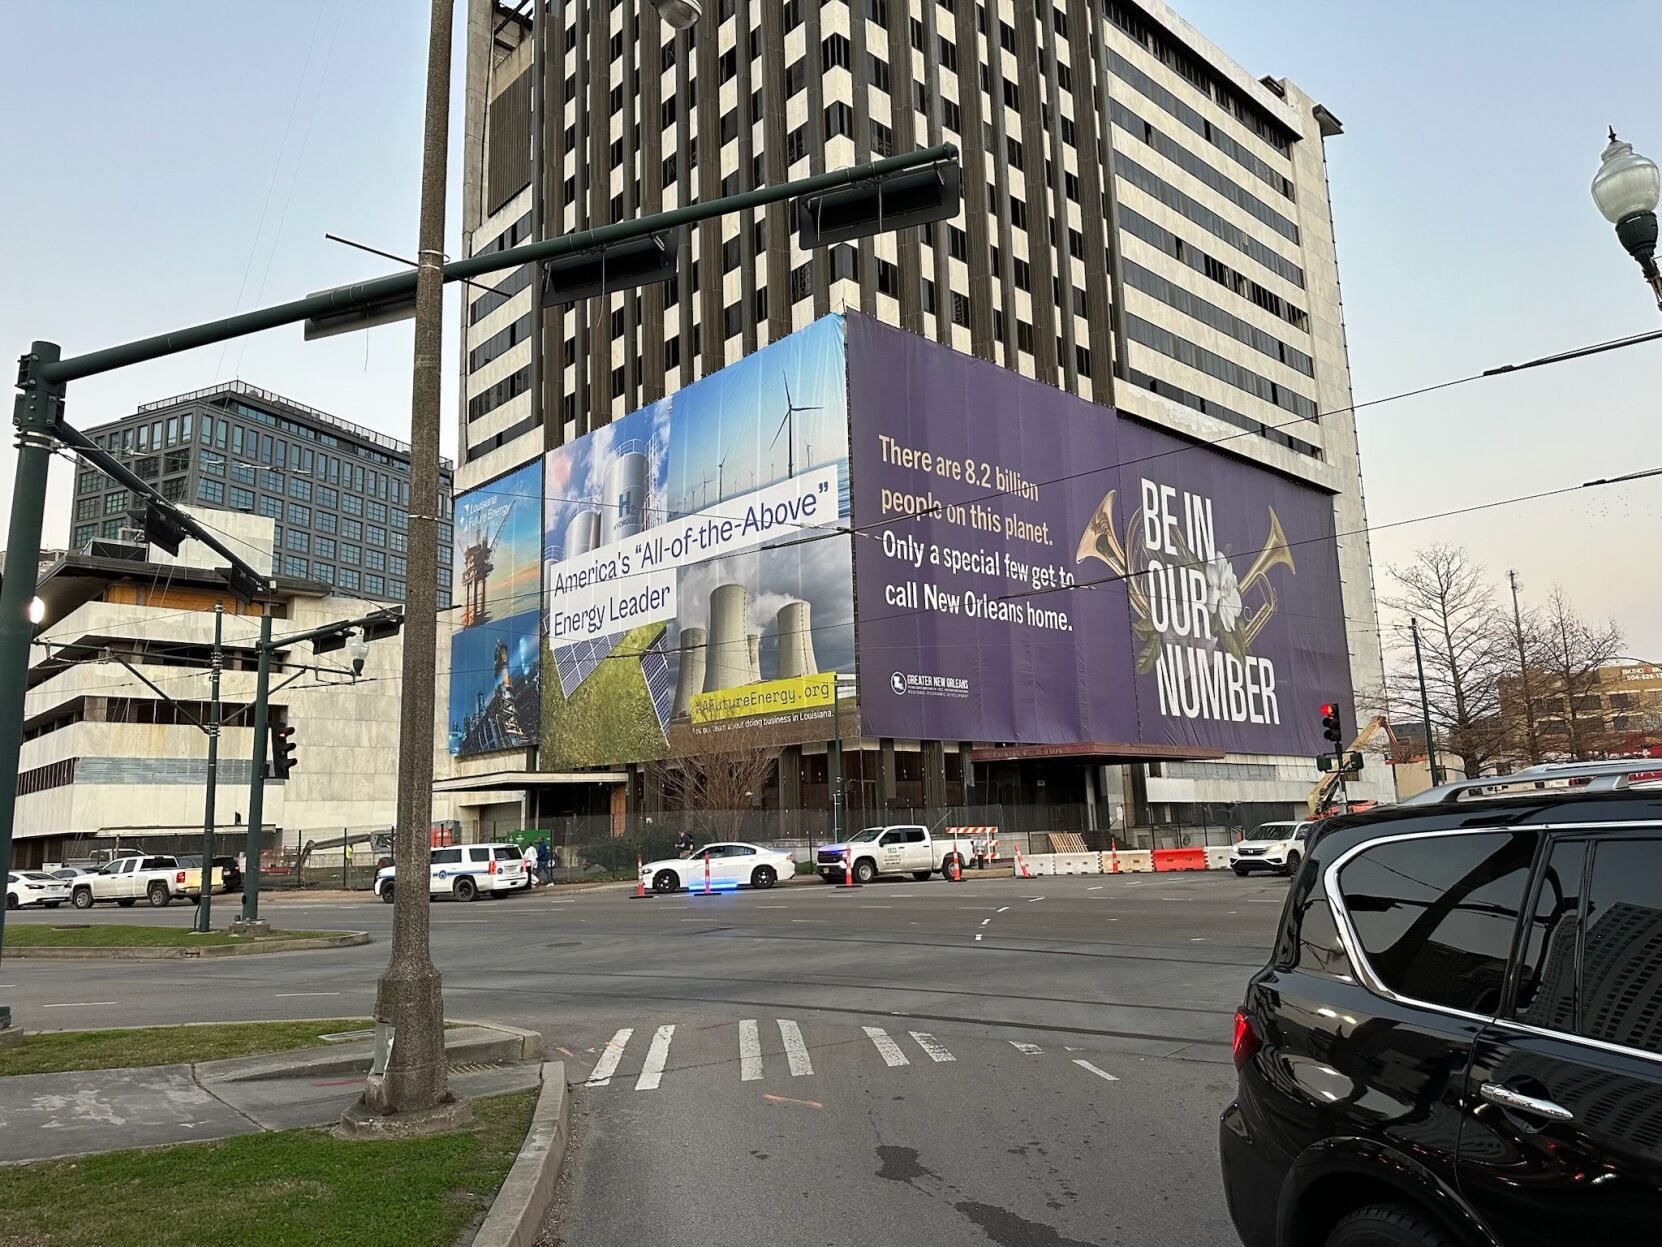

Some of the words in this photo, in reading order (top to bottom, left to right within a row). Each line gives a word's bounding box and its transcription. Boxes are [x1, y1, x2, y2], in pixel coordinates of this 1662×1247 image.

[879, 434, 932, 472] There
[936, 456, 961, 481] are
[965, 459, 992, 489] 8.2
[996, 466, 1039, 501] billion
[487, 503, 511, 520] Energy
[881, 488, 942, 521] people
[946, 503, 966, 526] on
[970, 504, 1001, 532] this
[1005, 513, 1053, 546] planet.
[1141, 477, 1178, 556] BE
[1183, 491, 1216, 565] IN
[554, 551, 631, 597] America's
[883, 530, 924, 568] Only
[930, 544, 940, 565] a
[944, 549, 1000, 576] special
[1004, 553, 1028, 582] few
[1032, 564, 1056, 590] get
[1059, 566, 1075, 590] to
[554, 605, 606, 637] Energy
[610, 585, 671, 622] Leader
[885, 581, 918, 609] call
[924, 583, 960, 614] New
[964, 591, 1024, 624] Orleans
[1027, 601, 1073, 632] home.
[1148, 559, 1211, 640] OUR
[907, 674, 933, 686] GREATER
[933, 676, 946, 687] NEW
[946, 677, 969, 689] ORLEANS
[1156, 643, 1280, 725] NUMBER
[744, 718, 762, 728] doing
[763, 714, 791, 725] business
[792, 713, 799, 721] in
[799, 709, 834, 721] Louisiana.
